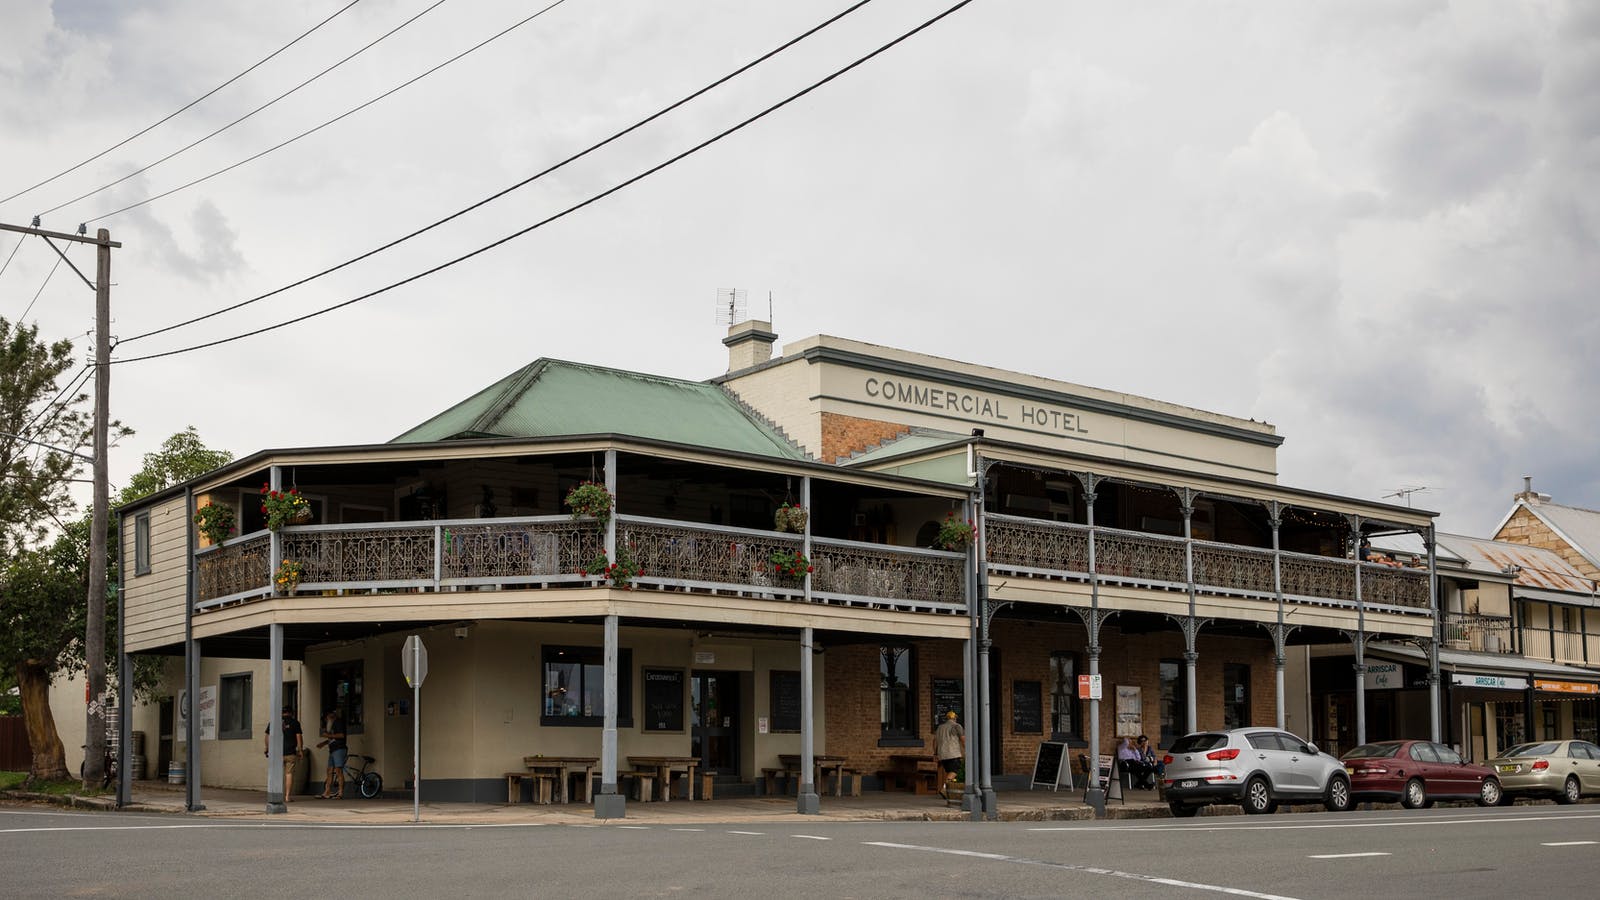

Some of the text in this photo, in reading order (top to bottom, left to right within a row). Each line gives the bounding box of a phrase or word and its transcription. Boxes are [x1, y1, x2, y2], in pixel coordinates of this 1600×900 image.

[865, 377, 1089, 434] COMMERCIAL HOTEL
[1367, 664, 1397, 673] ARRISCAR
[1475, 676, 1496, 686] ARRISCAR
